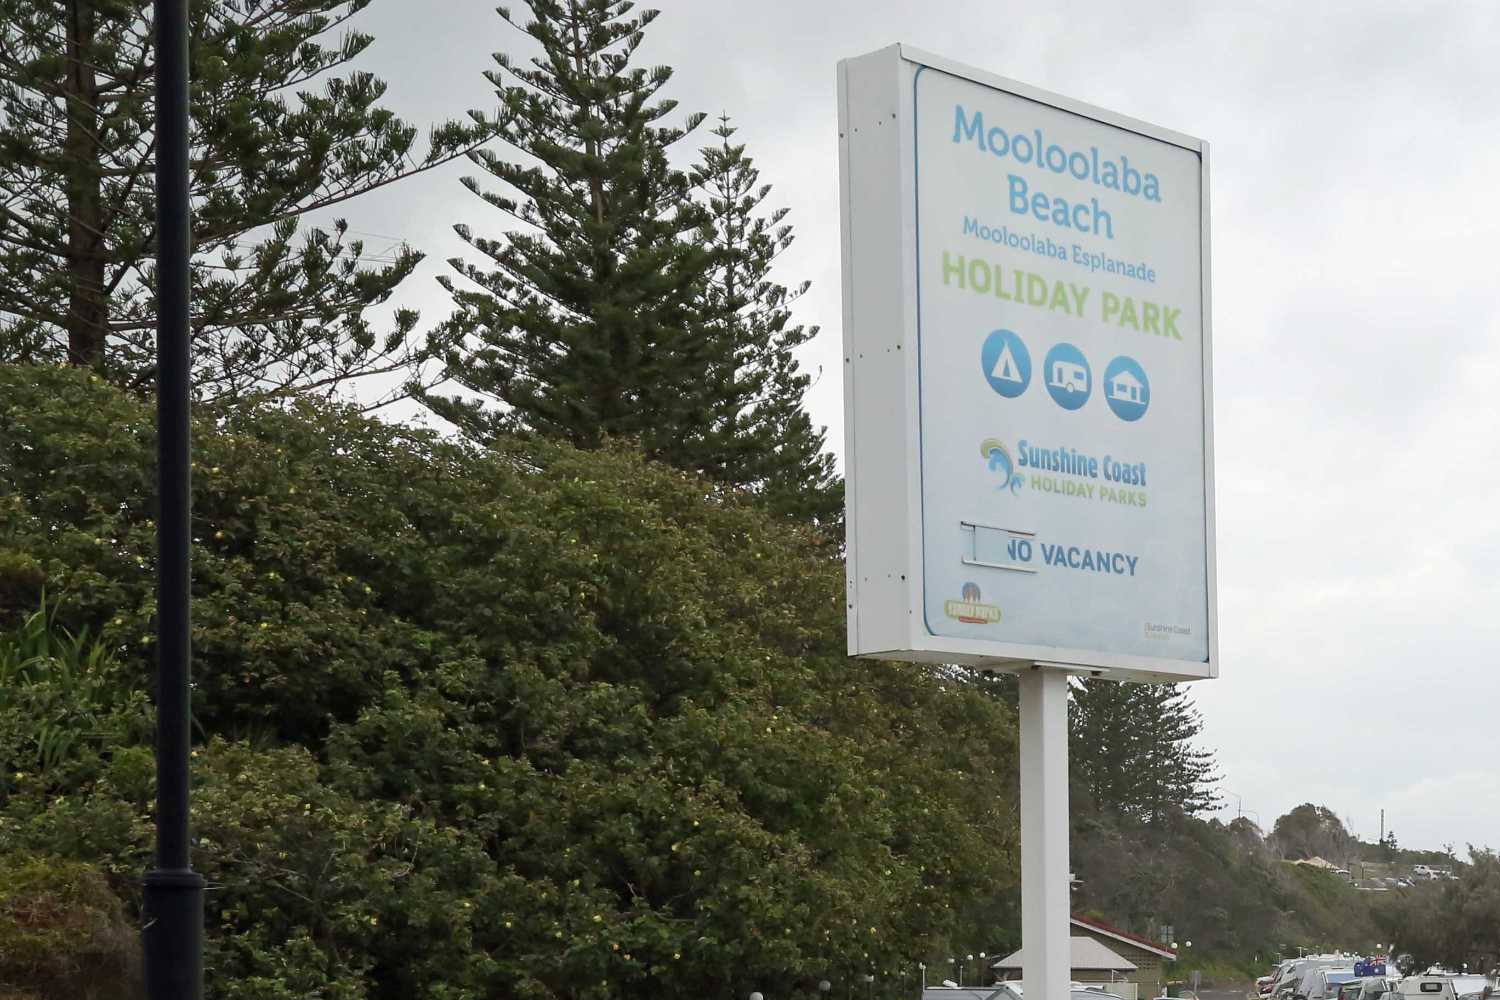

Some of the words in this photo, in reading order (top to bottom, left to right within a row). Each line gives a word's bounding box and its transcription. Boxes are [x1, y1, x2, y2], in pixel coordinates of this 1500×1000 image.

[952, 104, 1163, 203] Mooloolaba
[1007, 173, 1114, 240] Beach
[962, 215, 1068, 262] Mooloolaba
[1071, 244, 1157, 284] Esplanade
[942, 250, 1090, 318] HOLIDAY
[1101, 290, 1183, 342] PARK
[1017, 439, 1099, 479] Sunshine
[1103, 455, 1147, 487] Coast
[1031, 473, 1096, 499] HOLIDAY
[1099, 484, 1148, 508] PARKS
[1007, 539, 1033, 563] NO
[1041, 543, 1139, 577] VACANCY
